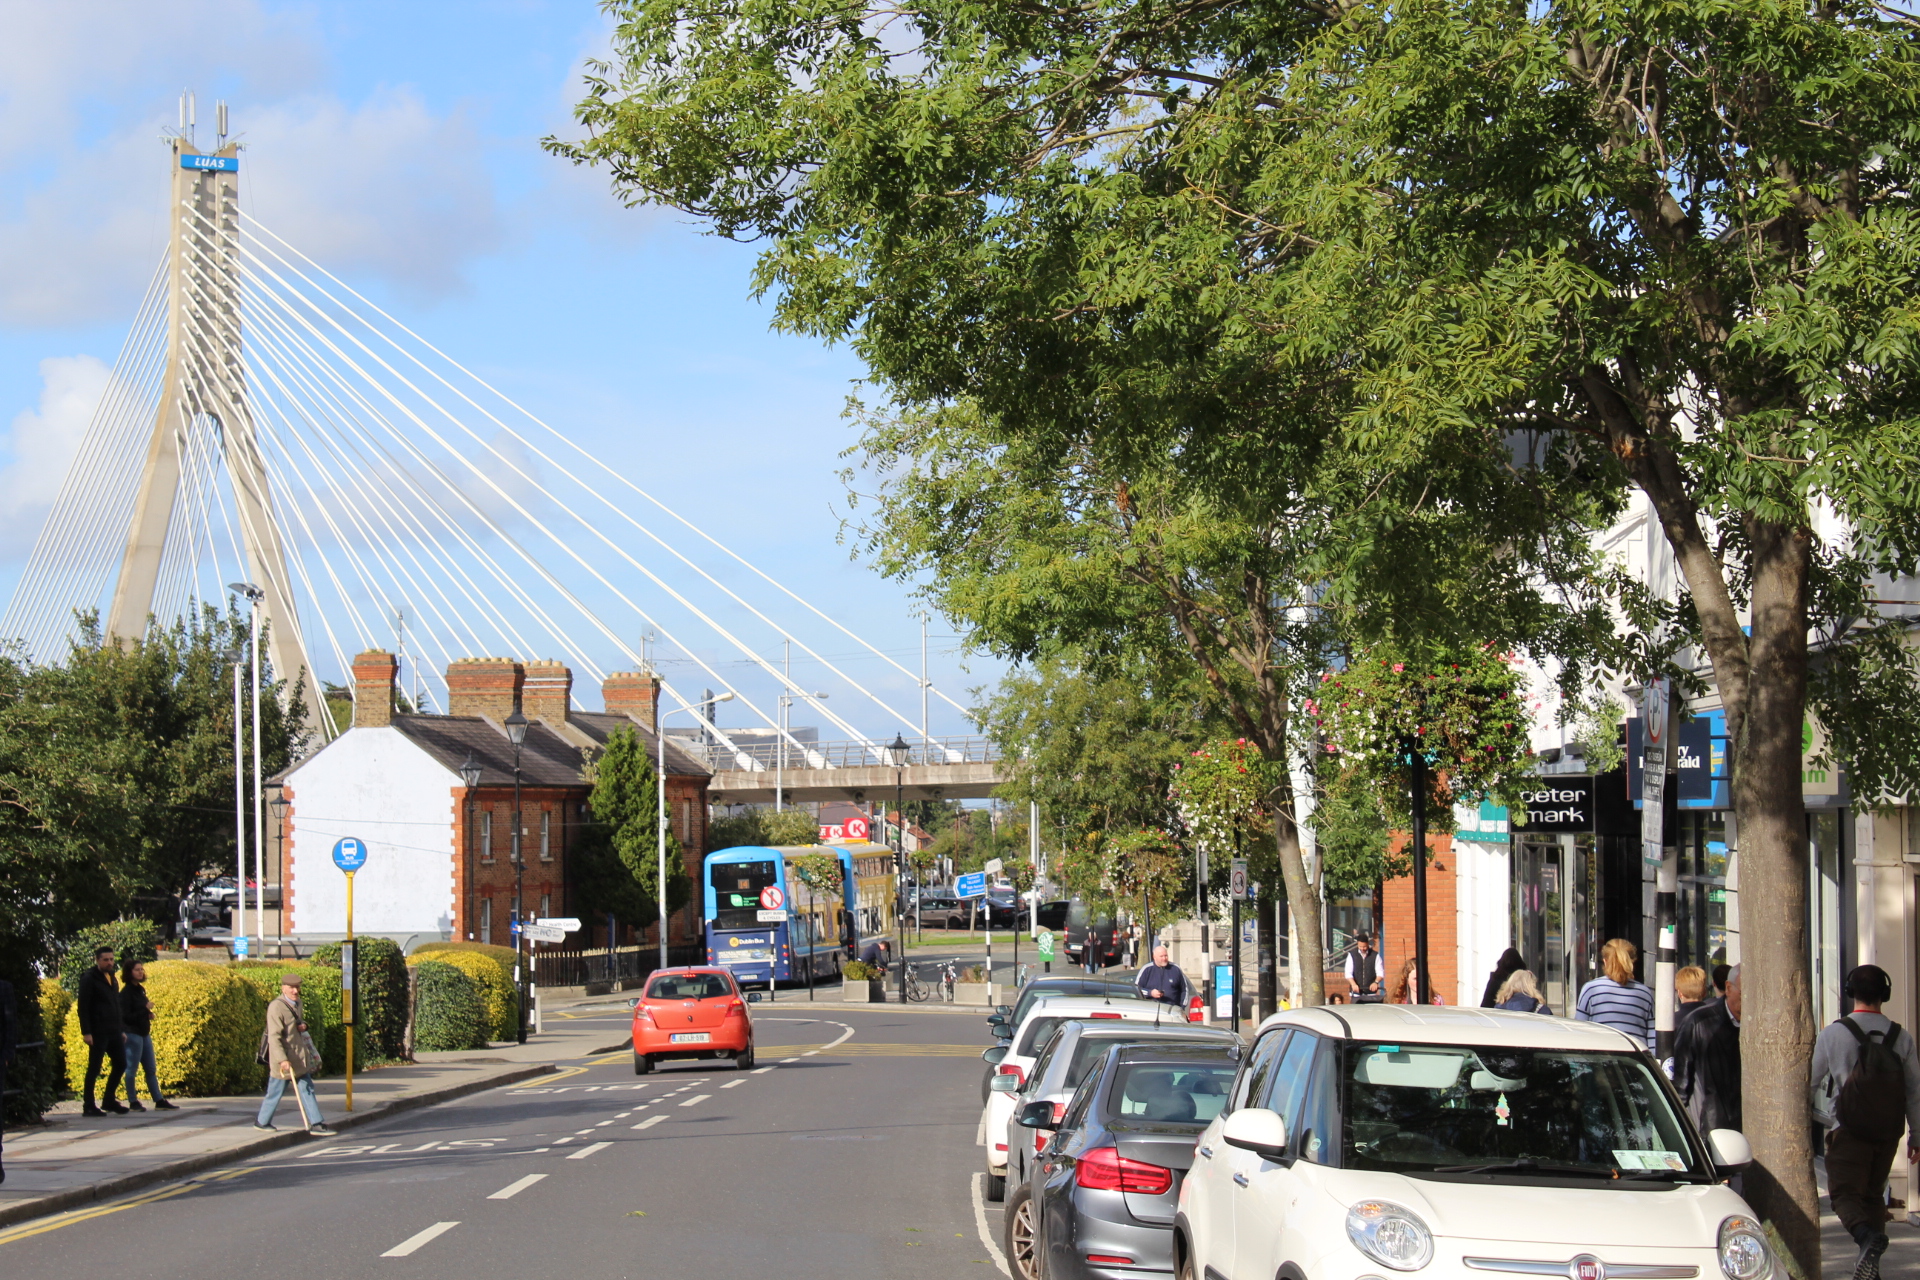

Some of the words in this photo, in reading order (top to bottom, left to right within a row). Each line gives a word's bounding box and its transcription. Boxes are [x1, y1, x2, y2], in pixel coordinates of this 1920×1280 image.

[195, 157, 225, 168] LUAS
[1520, 788, 1586, 804] peter
[1526, 807, 1584, 823] mark
[506, 1084, 649, 1095] BUS
[297, 1139, 507, 1158] BUS
[1581, 1265, 1595, 1277] FIAT
